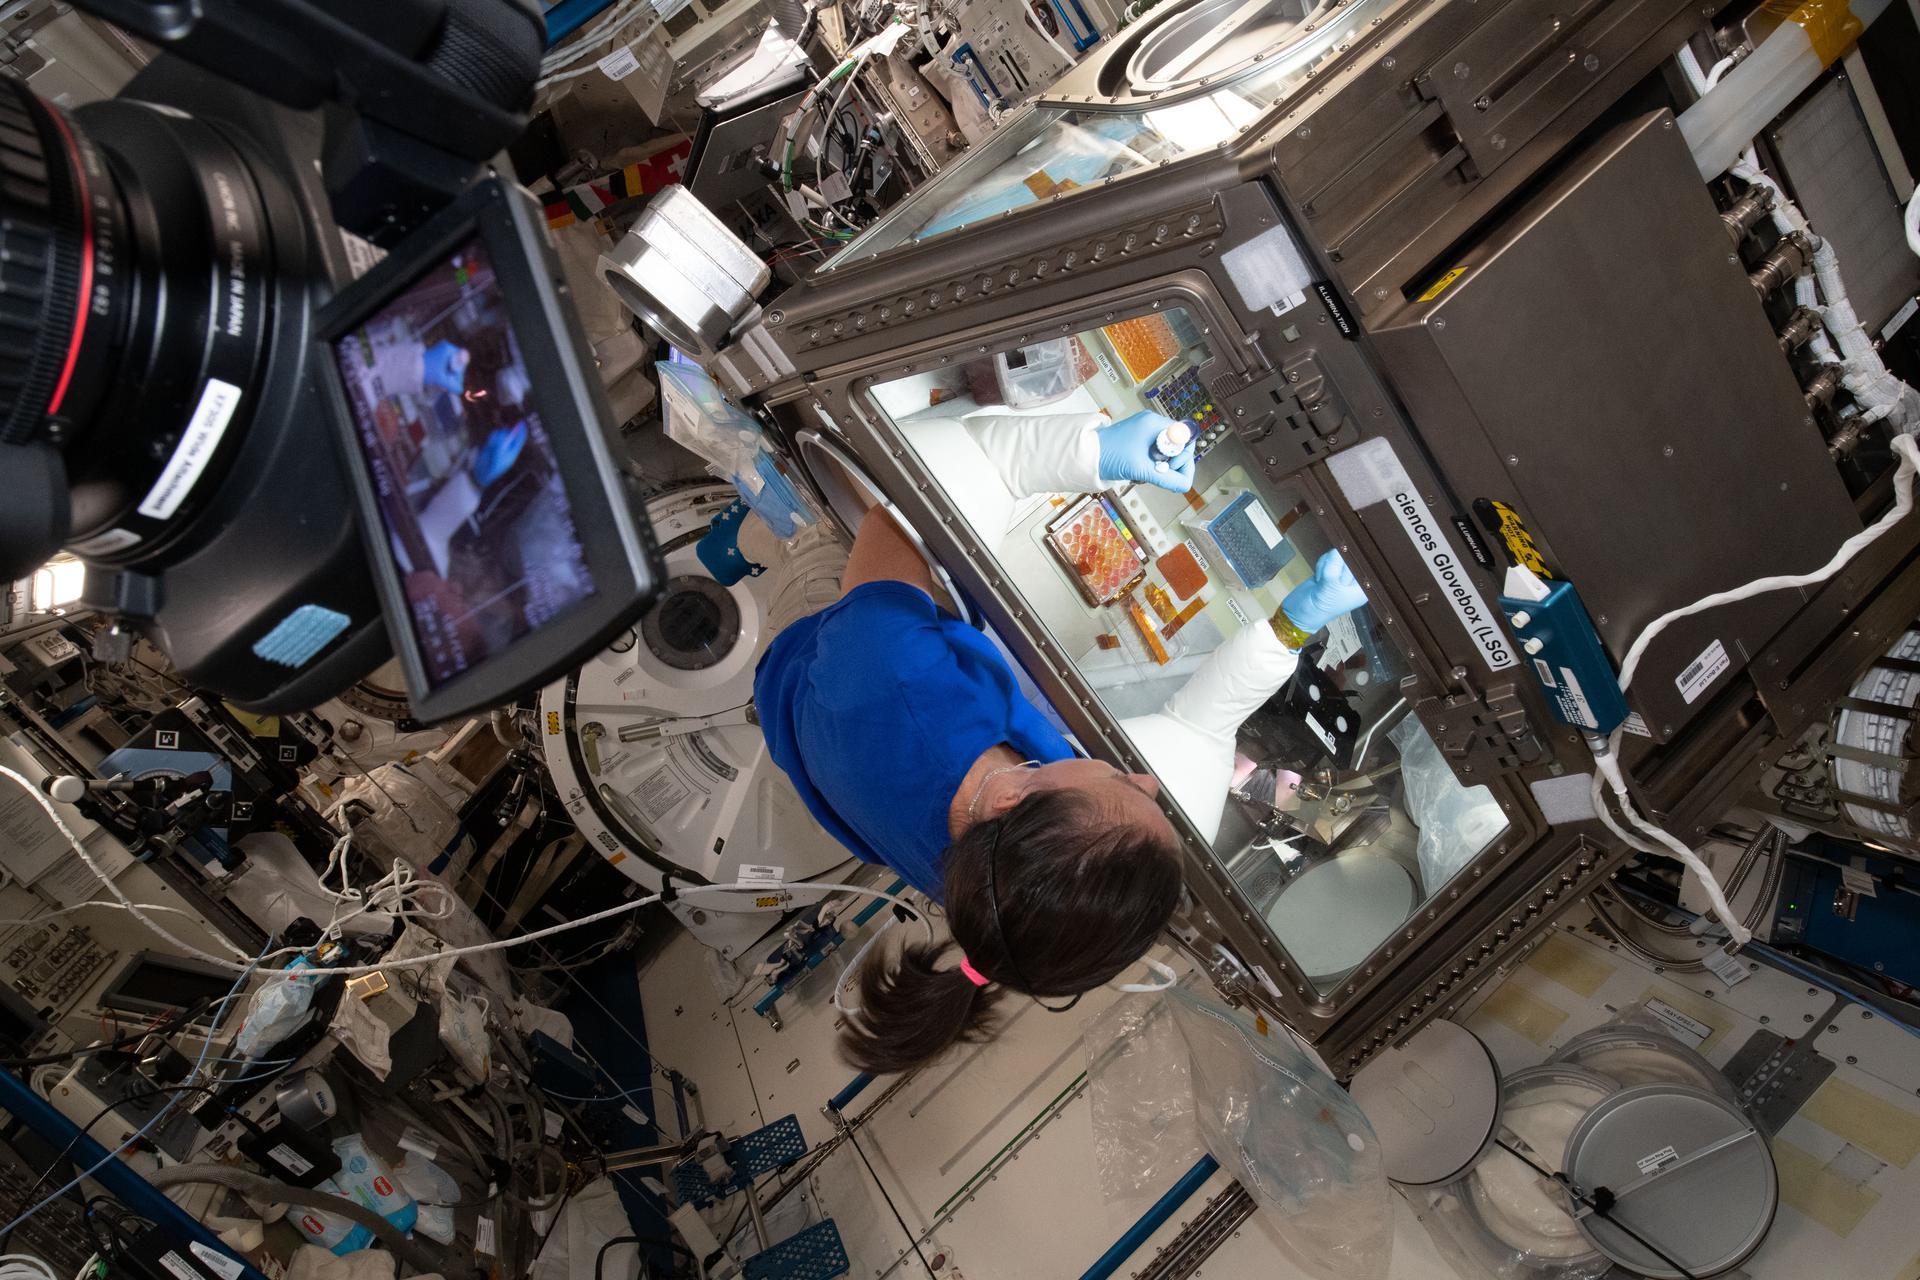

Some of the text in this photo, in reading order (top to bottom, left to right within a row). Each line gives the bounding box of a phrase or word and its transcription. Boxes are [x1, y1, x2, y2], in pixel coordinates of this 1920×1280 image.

[230, 278, 244, 294] IN
[227, 293, 244, 335] JAPAN
[1318, 285, 1350, 333] ILLUMINATION
[1098, 355, 1117, 380] Blue Tips
[152, 457, 191, 512] Attachment
[1457, 521, 1486, 562] ILLUMINATION
[1504, 524, 1516, 537] HOT
[1506, 515, 1527, 548] WARNING
[1187, 541, 1206, 569] Yellow Tips
[1393, 490, 1511, 669] ciences Glovebox (LSG)
[1228, 599, 1242, 618] Sample
[1706, 665, 1720, 679] E-Box
[1719, 657, 1729, 667] Fan
[1698, 678, 1706, 686] Lid
